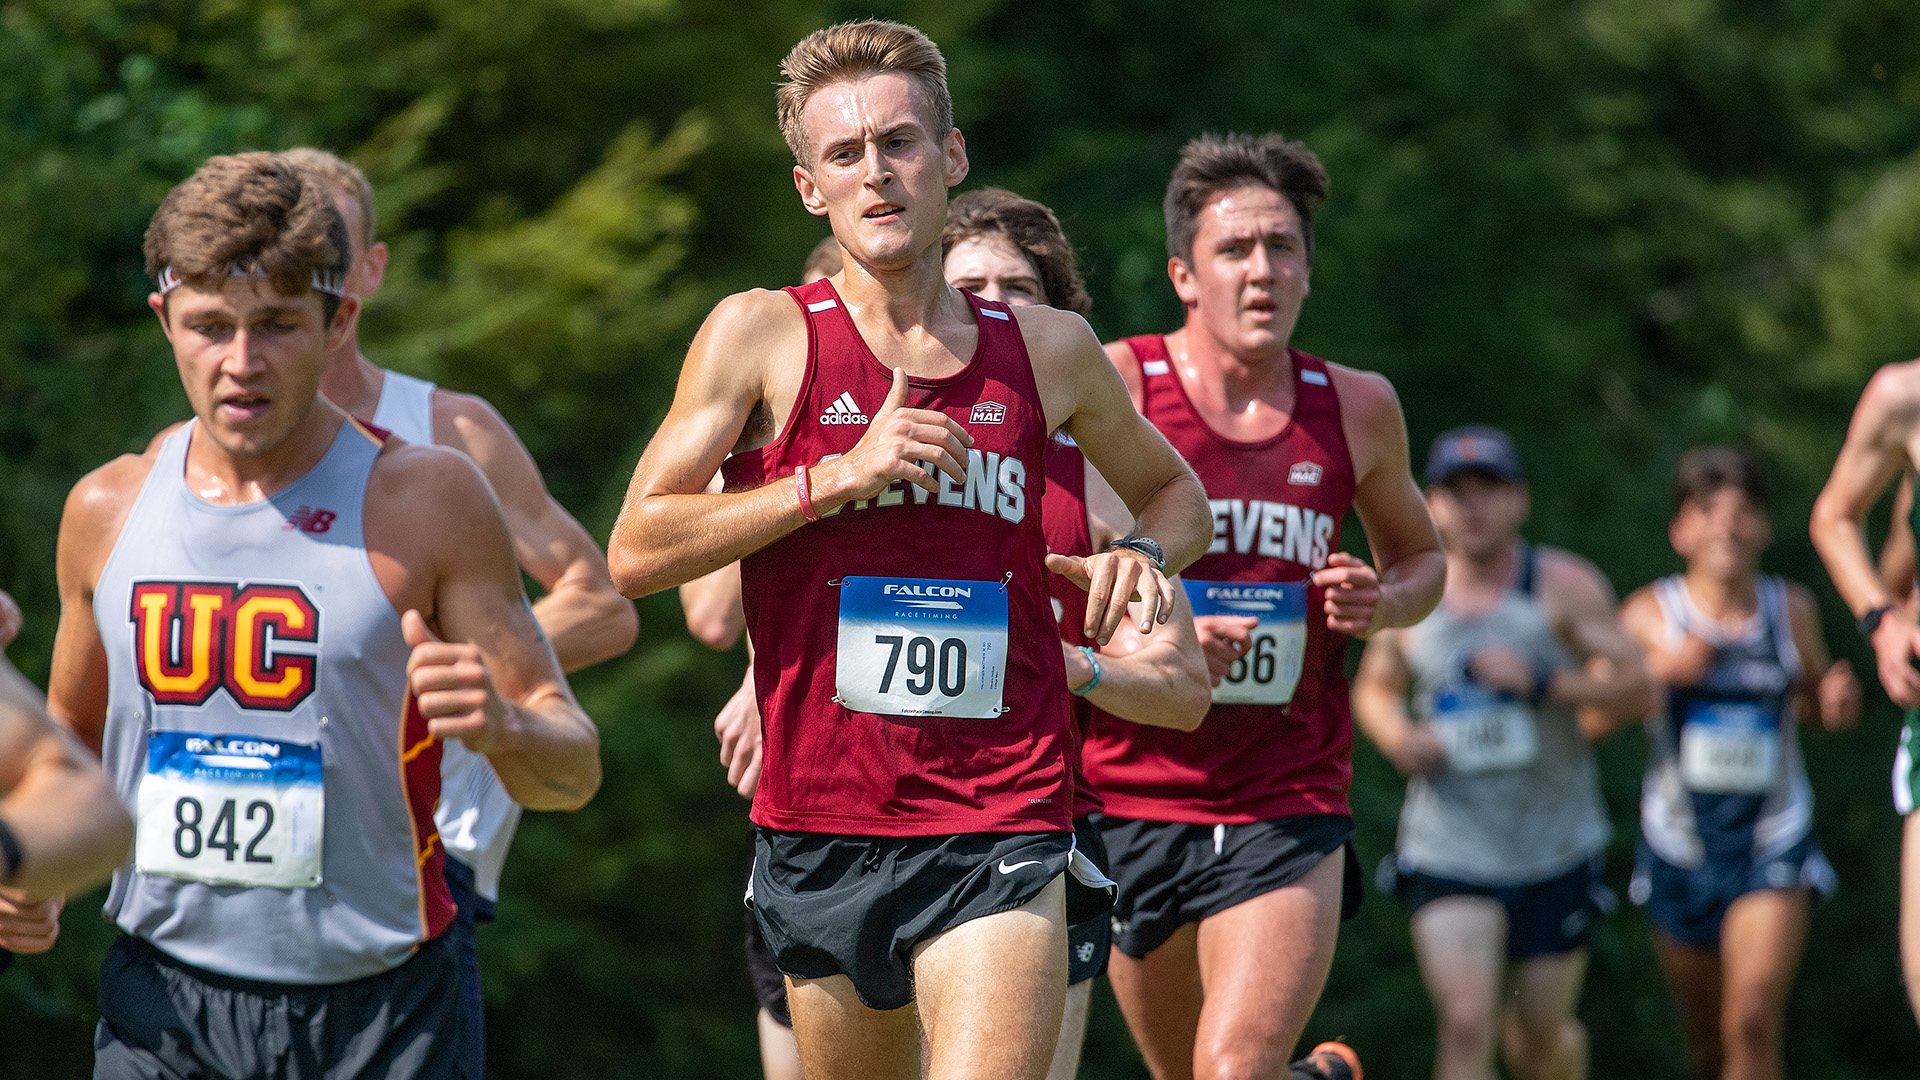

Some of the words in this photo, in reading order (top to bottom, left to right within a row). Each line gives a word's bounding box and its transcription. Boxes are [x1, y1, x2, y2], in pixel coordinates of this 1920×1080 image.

[819, 412, 869, 425] adidas
[972, 411, 1003, 422] MAC
[799, 485, 807, 502] Run?
[820, 447, 1027, 525] EVENS
[1206, 498, 1335, 570] EVENS
[883, 584, 971, 598] FALCON
[1206, 587, 1284, 601] FALCON
[922, 612, 958, 620] TIMING
[130, 581, 319, 712] UC
[875, 634, 967, 698] 790
[185, 737, 281, 758] FALCON
[173, 797, 275, 863] 842
